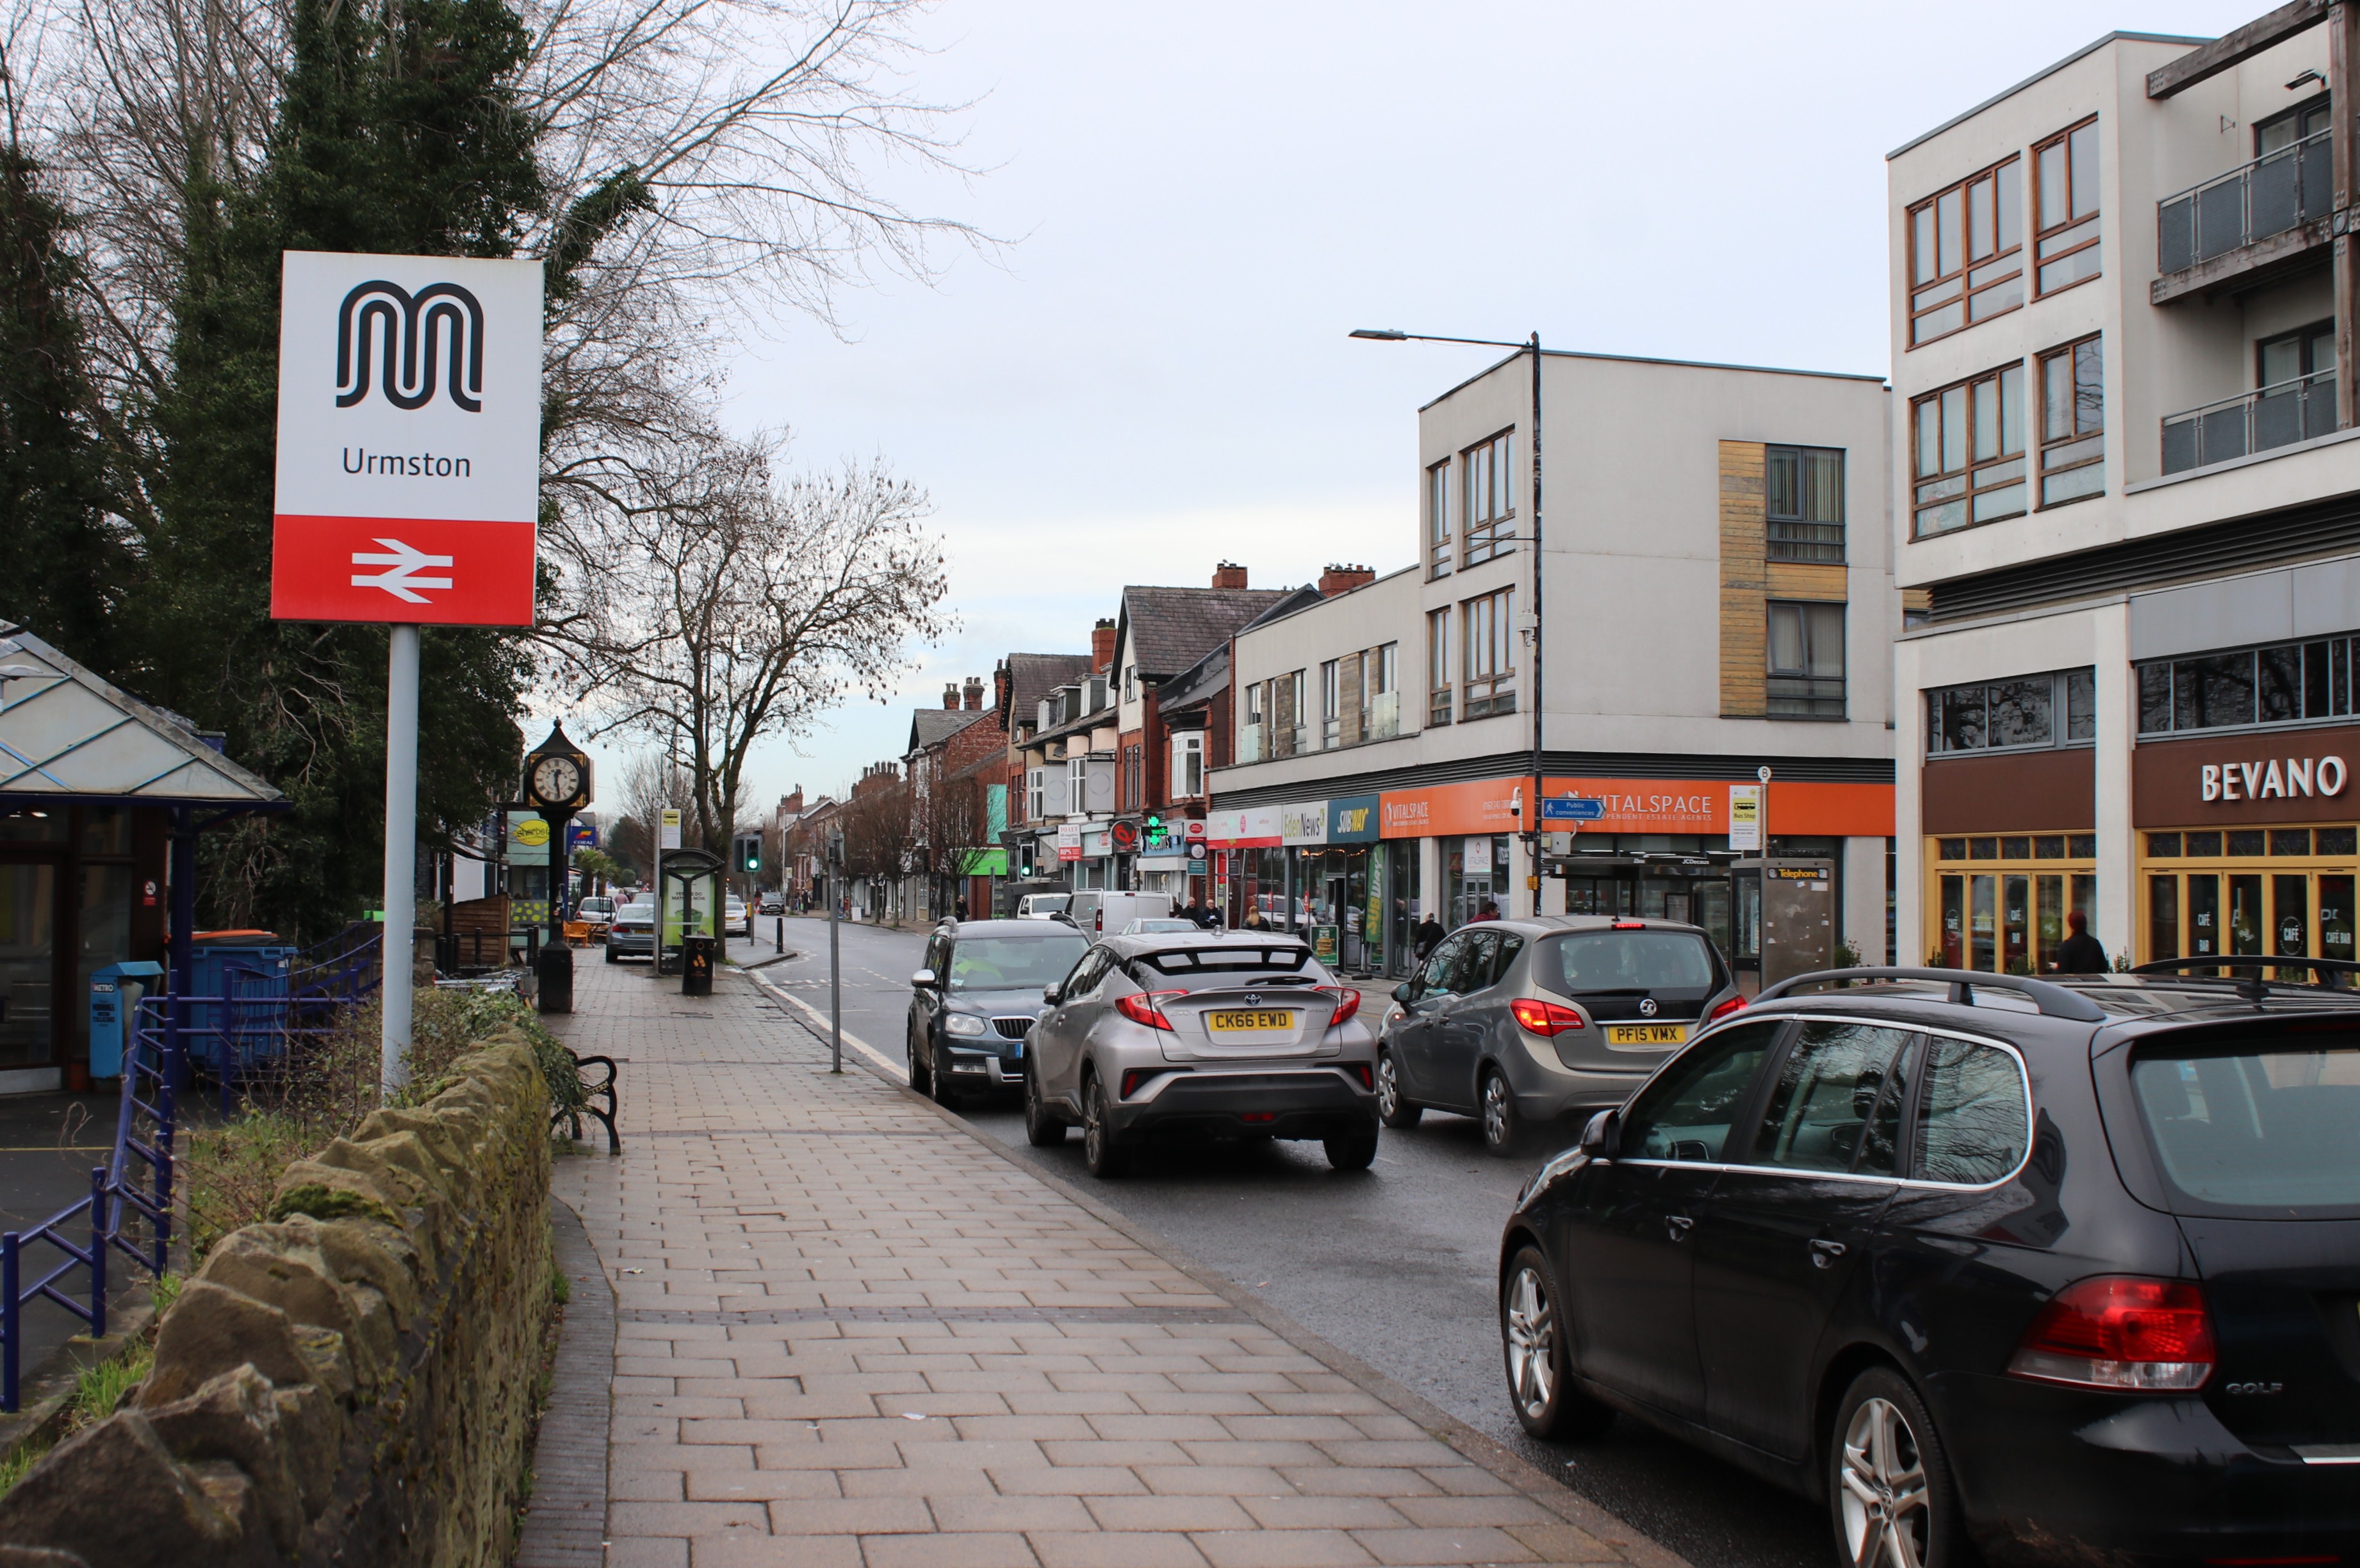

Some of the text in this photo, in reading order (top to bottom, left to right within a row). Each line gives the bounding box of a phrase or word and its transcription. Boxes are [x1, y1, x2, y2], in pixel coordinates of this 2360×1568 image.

[342, 446, 471, 477] Urmston
[1762, 768, 1768, 778] B
[2202, 755, 2348, 801] BEVANO
[1392, 801, 1429, 820] VITALSPACE
[1284, 813, 1320, 838] EdenNews
[1337, 808, 1369, 833] SUBWAY
[1778, 869, 1818, 879] Telephone
[1366, 852, 1383, 935] SUBWAY
[2198, 911, 2211, 926] CAFÉ
[2283, 925, 2299, 942] CAFÉ
[2326, 929, 2351, 944] CAFÉ BAR
[2199, 939, 2209, 952] BAR
[93, 984, 113, 992] METRO
[1215, 1013, 1288, 1029] CK66 EWD
[1616, 1027, 1678, 1041] PF15 VMX
[2225, 1382, 2283, 1394] GOLF
